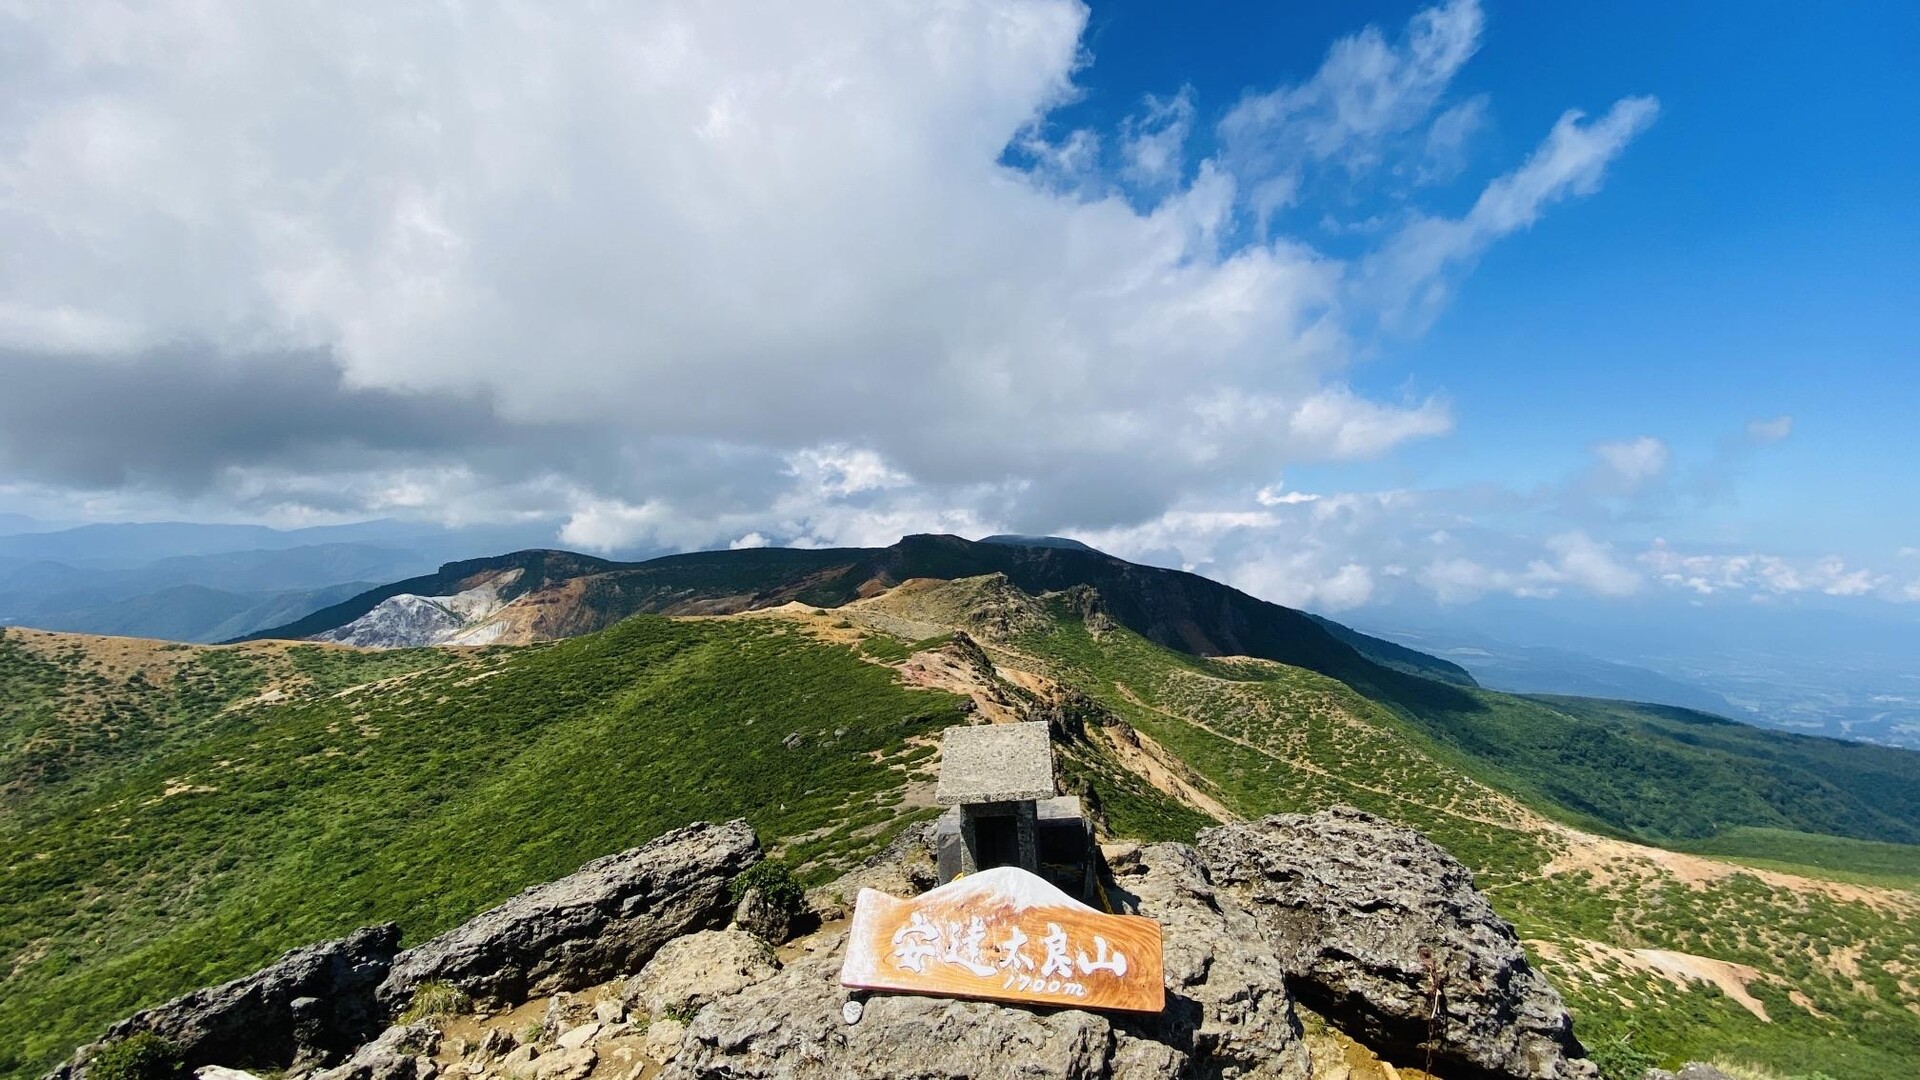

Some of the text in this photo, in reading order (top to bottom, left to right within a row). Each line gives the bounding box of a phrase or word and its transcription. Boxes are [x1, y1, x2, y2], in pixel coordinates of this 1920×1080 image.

[892, 911, 1128, 977] 安達太良山
[1003, 974, 1086, 997] 1700m
